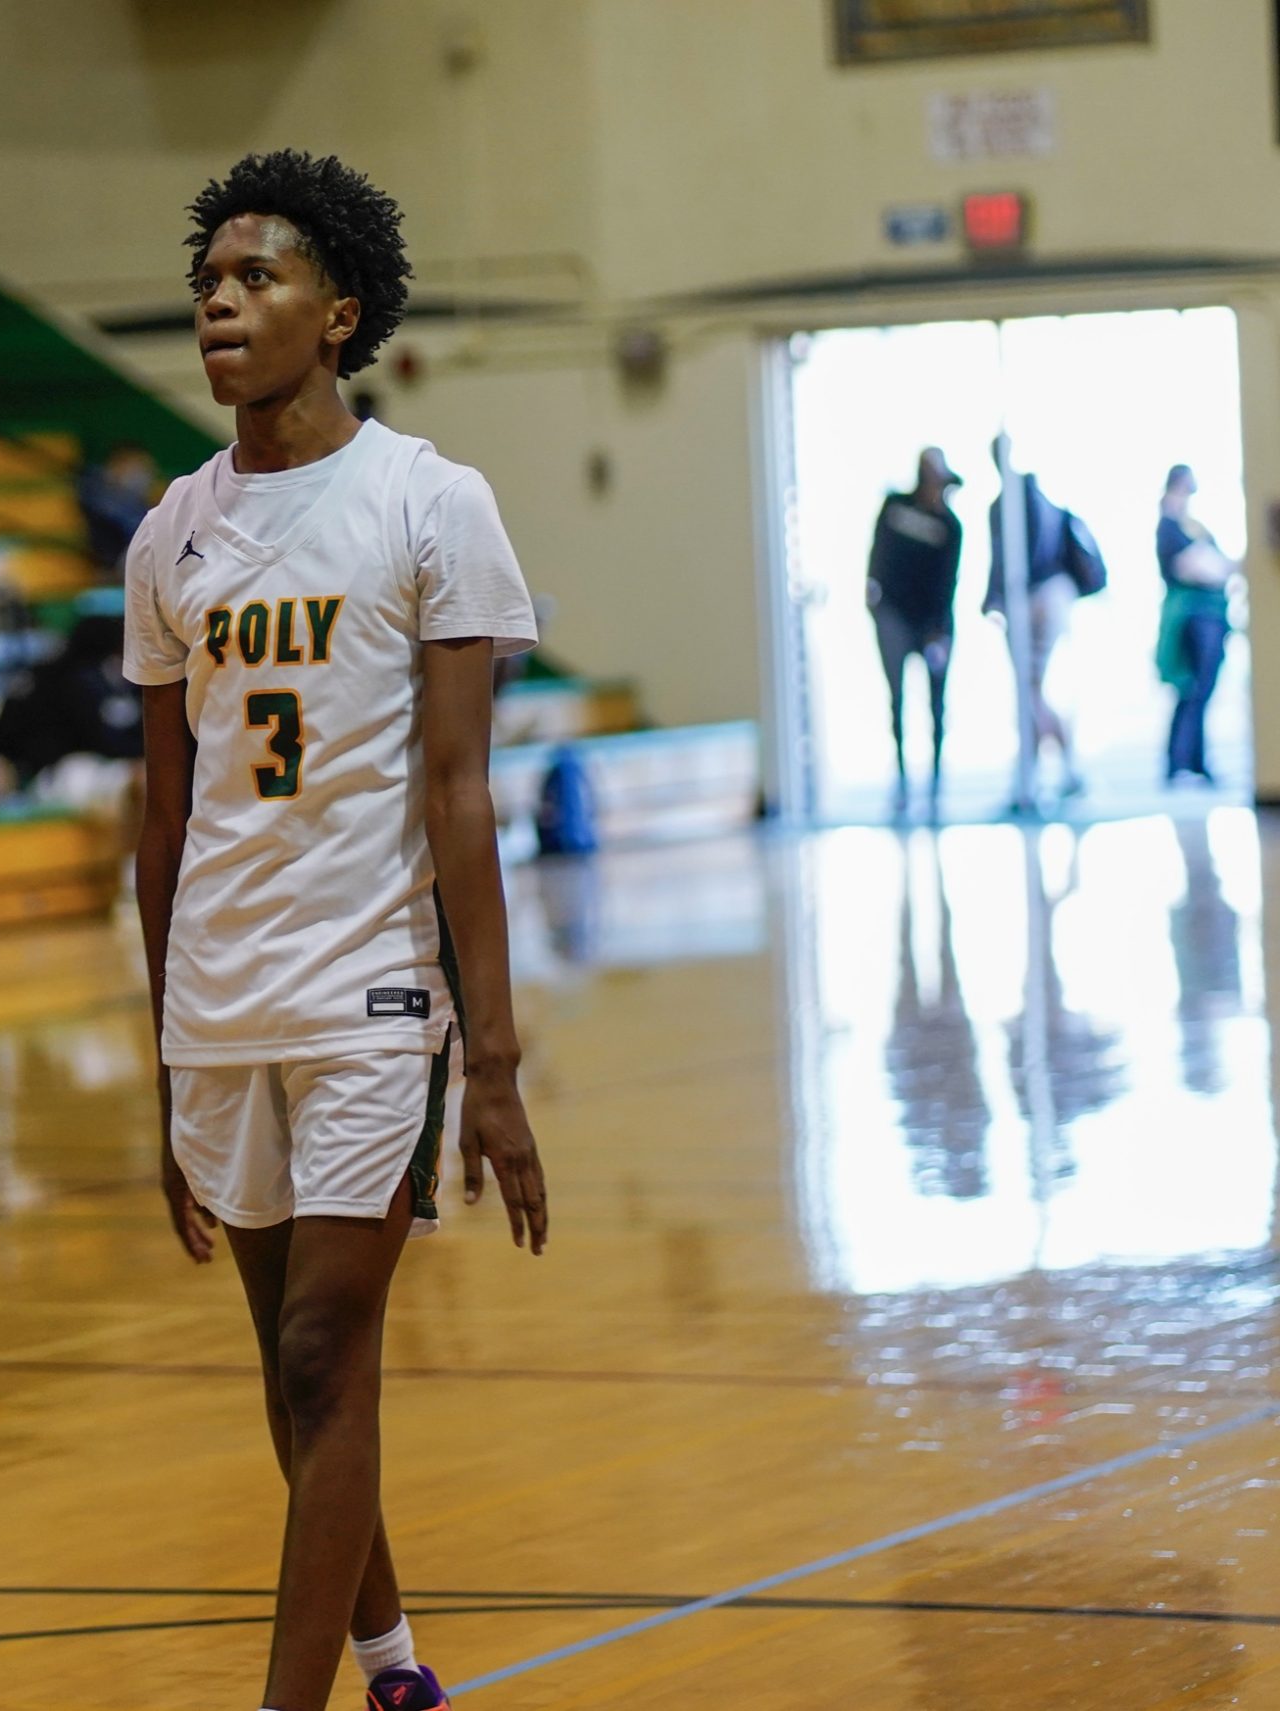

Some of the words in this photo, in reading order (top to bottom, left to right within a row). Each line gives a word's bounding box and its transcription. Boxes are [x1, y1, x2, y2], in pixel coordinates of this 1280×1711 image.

[204, 595, 346, 668] POLY
[243, 688, 306, 802] 3
[412, 996, 423, 1008] M
